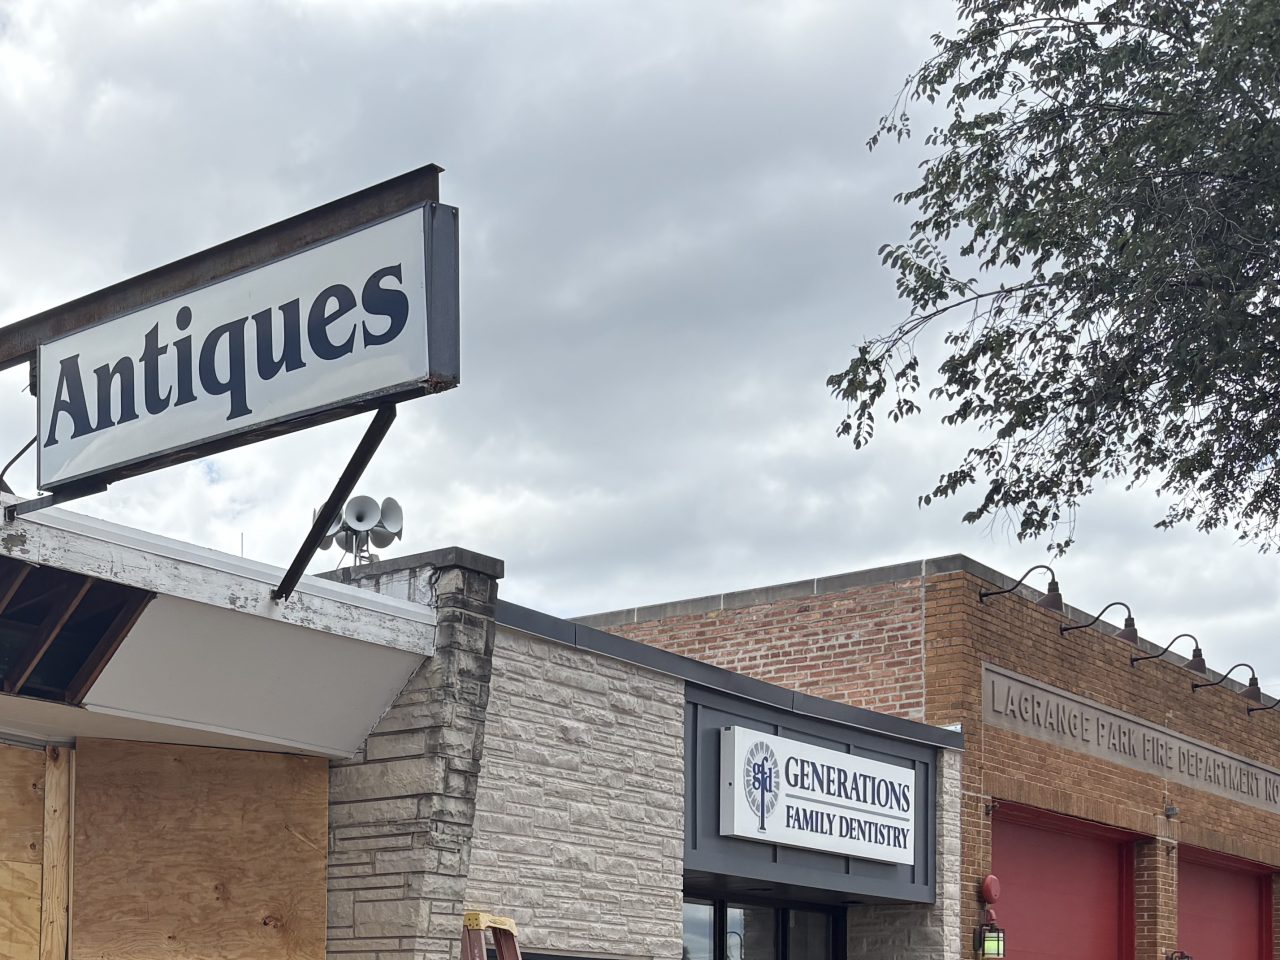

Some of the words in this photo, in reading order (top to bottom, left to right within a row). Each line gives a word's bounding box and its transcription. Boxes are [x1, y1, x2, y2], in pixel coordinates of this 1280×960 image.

[43, 262, 410, 448] Antiques
[991, 679, 1091, 743] LAGRANGE
[1097, 716, 1138, 758] PARK
[1142, 732, 1173, 770] FIRE
[1178, 745, 1262, 799] DEPARTMENT
[784, 756, 911, 813] GENERATIONS
[785, 805, 837, 836] FAMILY
[839, 815, 910, 850] DENTISTRY
